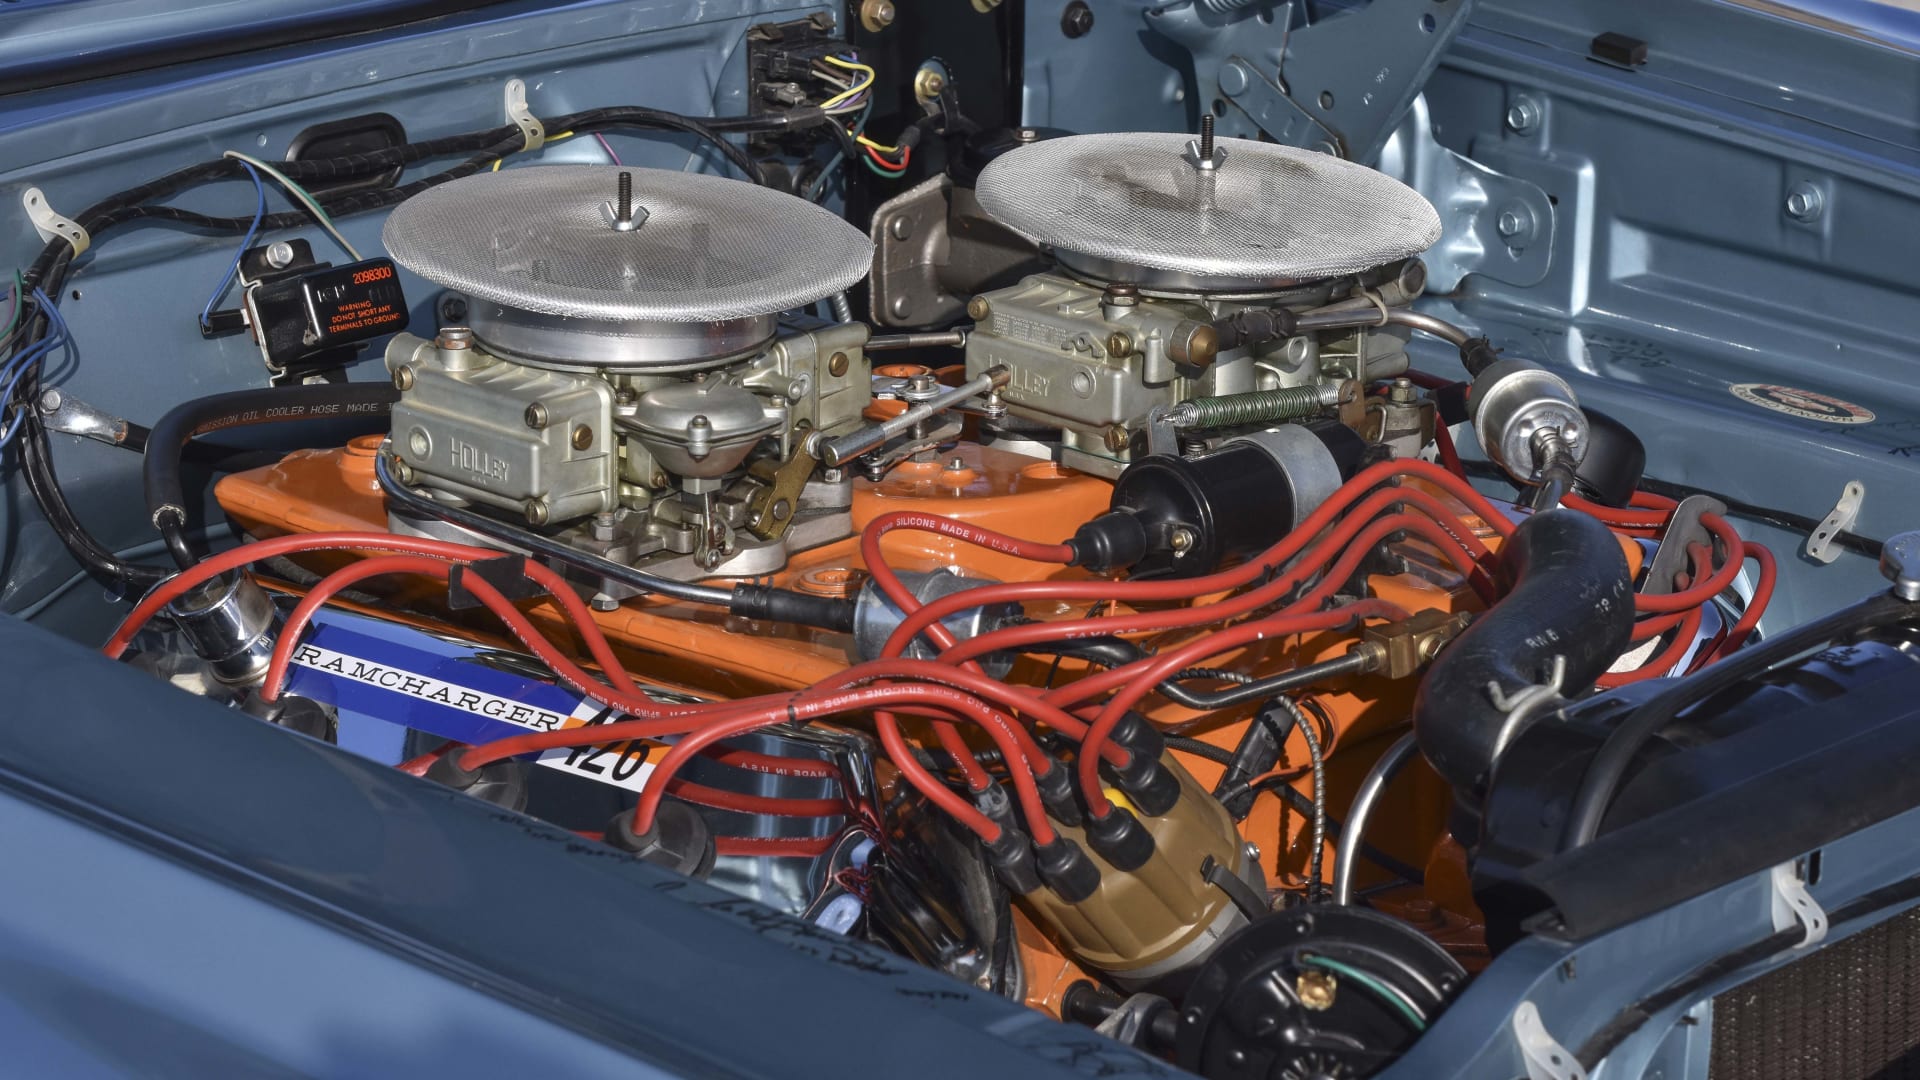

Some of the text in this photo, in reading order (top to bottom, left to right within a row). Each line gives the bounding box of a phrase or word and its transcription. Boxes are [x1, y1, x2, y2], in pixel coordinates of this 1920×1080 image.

[352, 266, 392, 285] 2098300
[332, 304, 392, 324] DO NOT SHORT ANY
[338, 300, 372, 312] WARNING
[328, 312, 401, 334] TERMINALS TO GROUND
[989, 354, 1050, 398] LLEY
[242, 411, 259, 423] OIL
[265, 405, 304, 418] COOLER
[310, 403, 340, 415] HOSE
[346, 402, 379, 413] MADE
[450, 436, 510, 482] HOLLEY
[896, 517, 936, 529] SILICONE
[940, 522, 970, 538] MADE
[974, 533, 986, 544] IN
[991, 538, 1021, 556] U.S.A.
[293, 646, 561, 732] RAMCHARGER
[553, 664, 587, 695] SILICONE
[824, 693, 859, 709] MADE
[865, 686, 925, 697] SILICONE
[612, 701, 630, 714] PRO
[634, 707, 660, 719] SPIRO
[806, 703, 819, 713] IN
